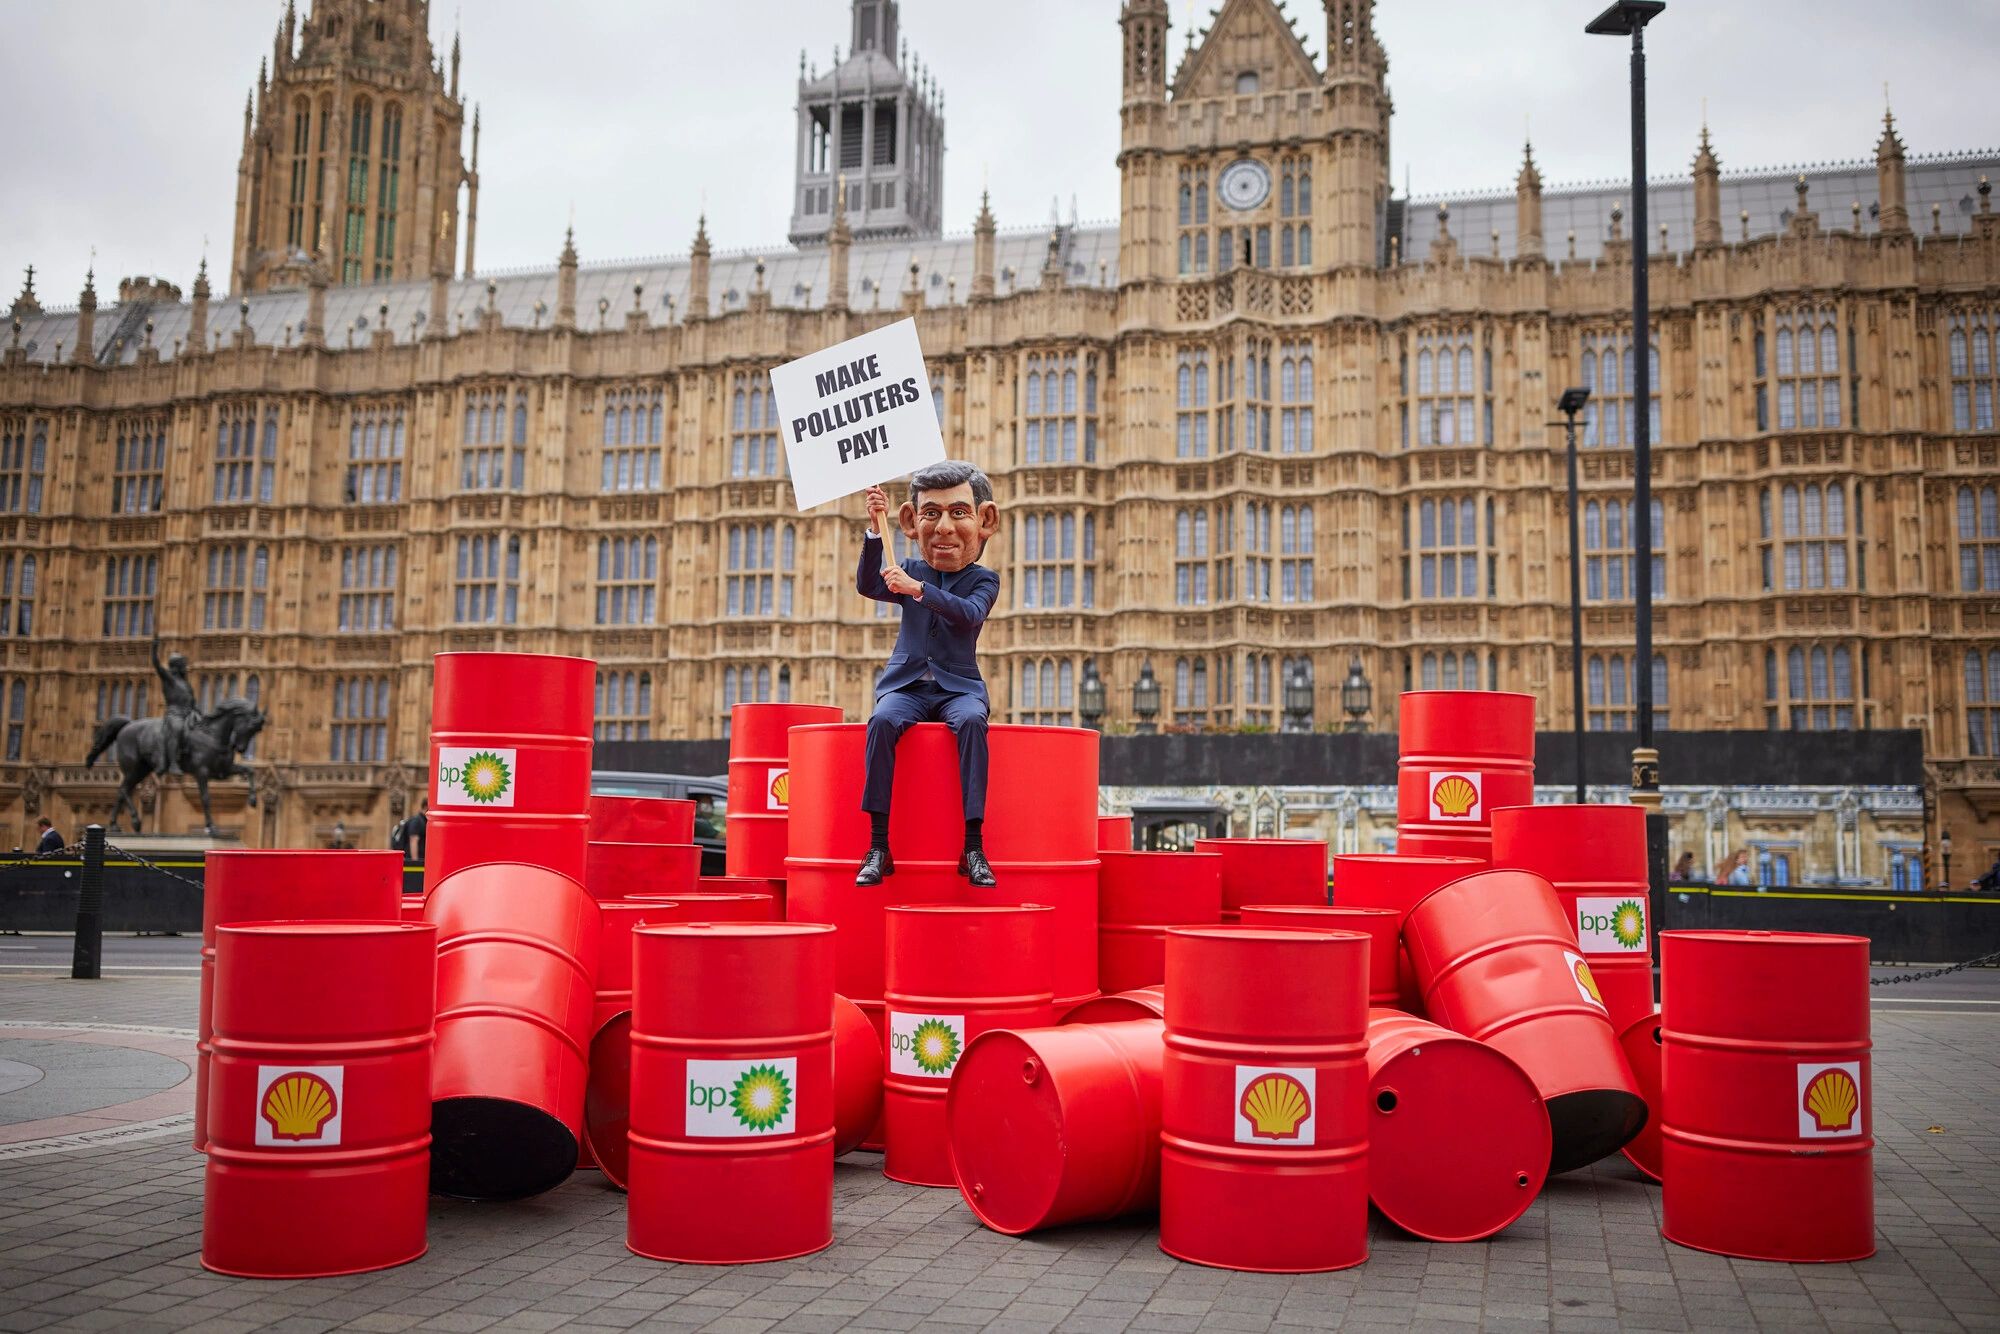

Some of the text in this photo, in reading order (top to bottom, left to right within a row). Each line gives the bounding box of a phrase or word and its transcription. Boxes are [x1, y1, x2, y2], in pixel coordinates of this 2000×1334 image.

[815, 353, 881, 398] MAKE
[792, 377, 920, 443] POLLUTERS
[837, 424, 890, 464] PAY!
[440, 762, 460, 788] bp
[1580, 911, 1608, 935] bp
[892, 1026, 910, 1056] bp
[689, 1079, 727, 1113] bp
